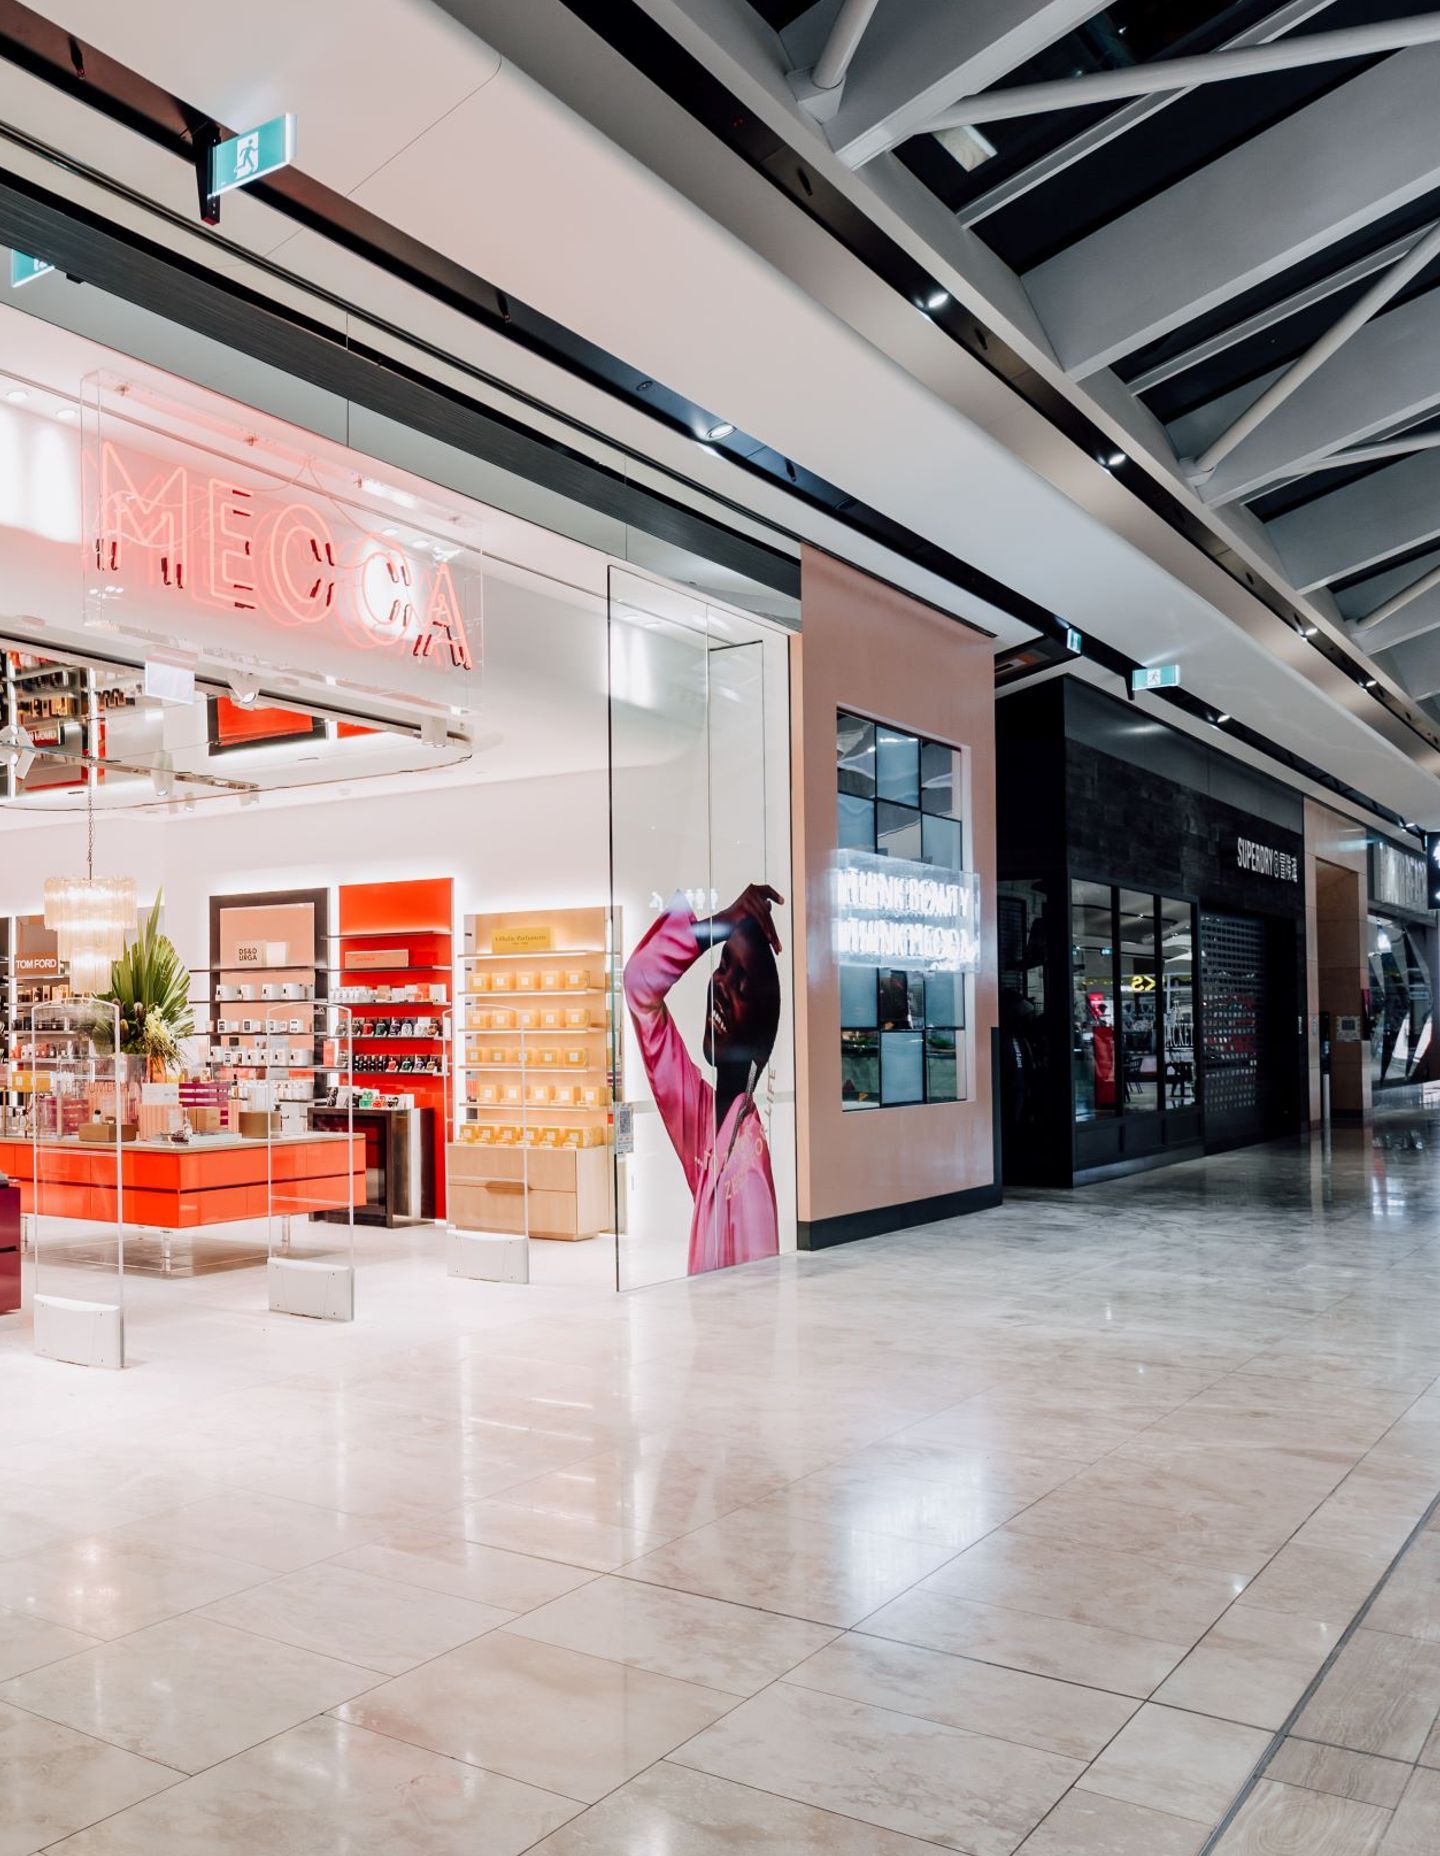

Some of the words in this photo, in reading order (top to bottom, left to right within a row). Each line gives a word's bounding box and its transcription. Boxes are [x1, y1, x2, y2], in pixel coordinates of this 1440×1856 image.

[101, 440, 473, 670] MECCA
[1237, 836, 1274, 876] SUPERDRY
[16, 959, 34, 969] TOM
[35, 959, 57, 969] FORD
